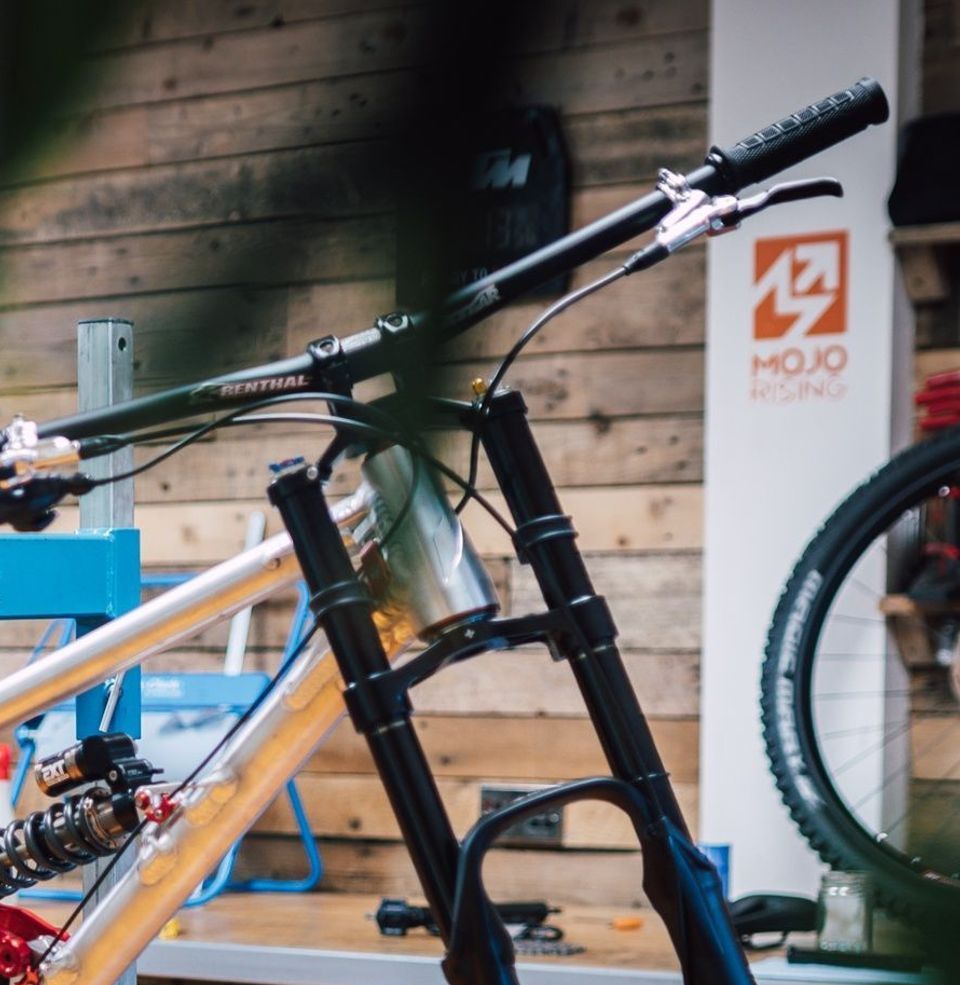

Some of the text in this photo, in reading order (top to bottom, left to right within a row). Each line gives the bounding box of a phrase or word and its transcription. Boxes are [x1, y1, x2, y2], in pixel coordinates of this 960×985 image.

[751, 344, 848, 376] MOJO
[221, 375, 309, 396] RENTHAL
[751, 378, 847, 402] RISING
[41, 760, 69, 786] EXT
